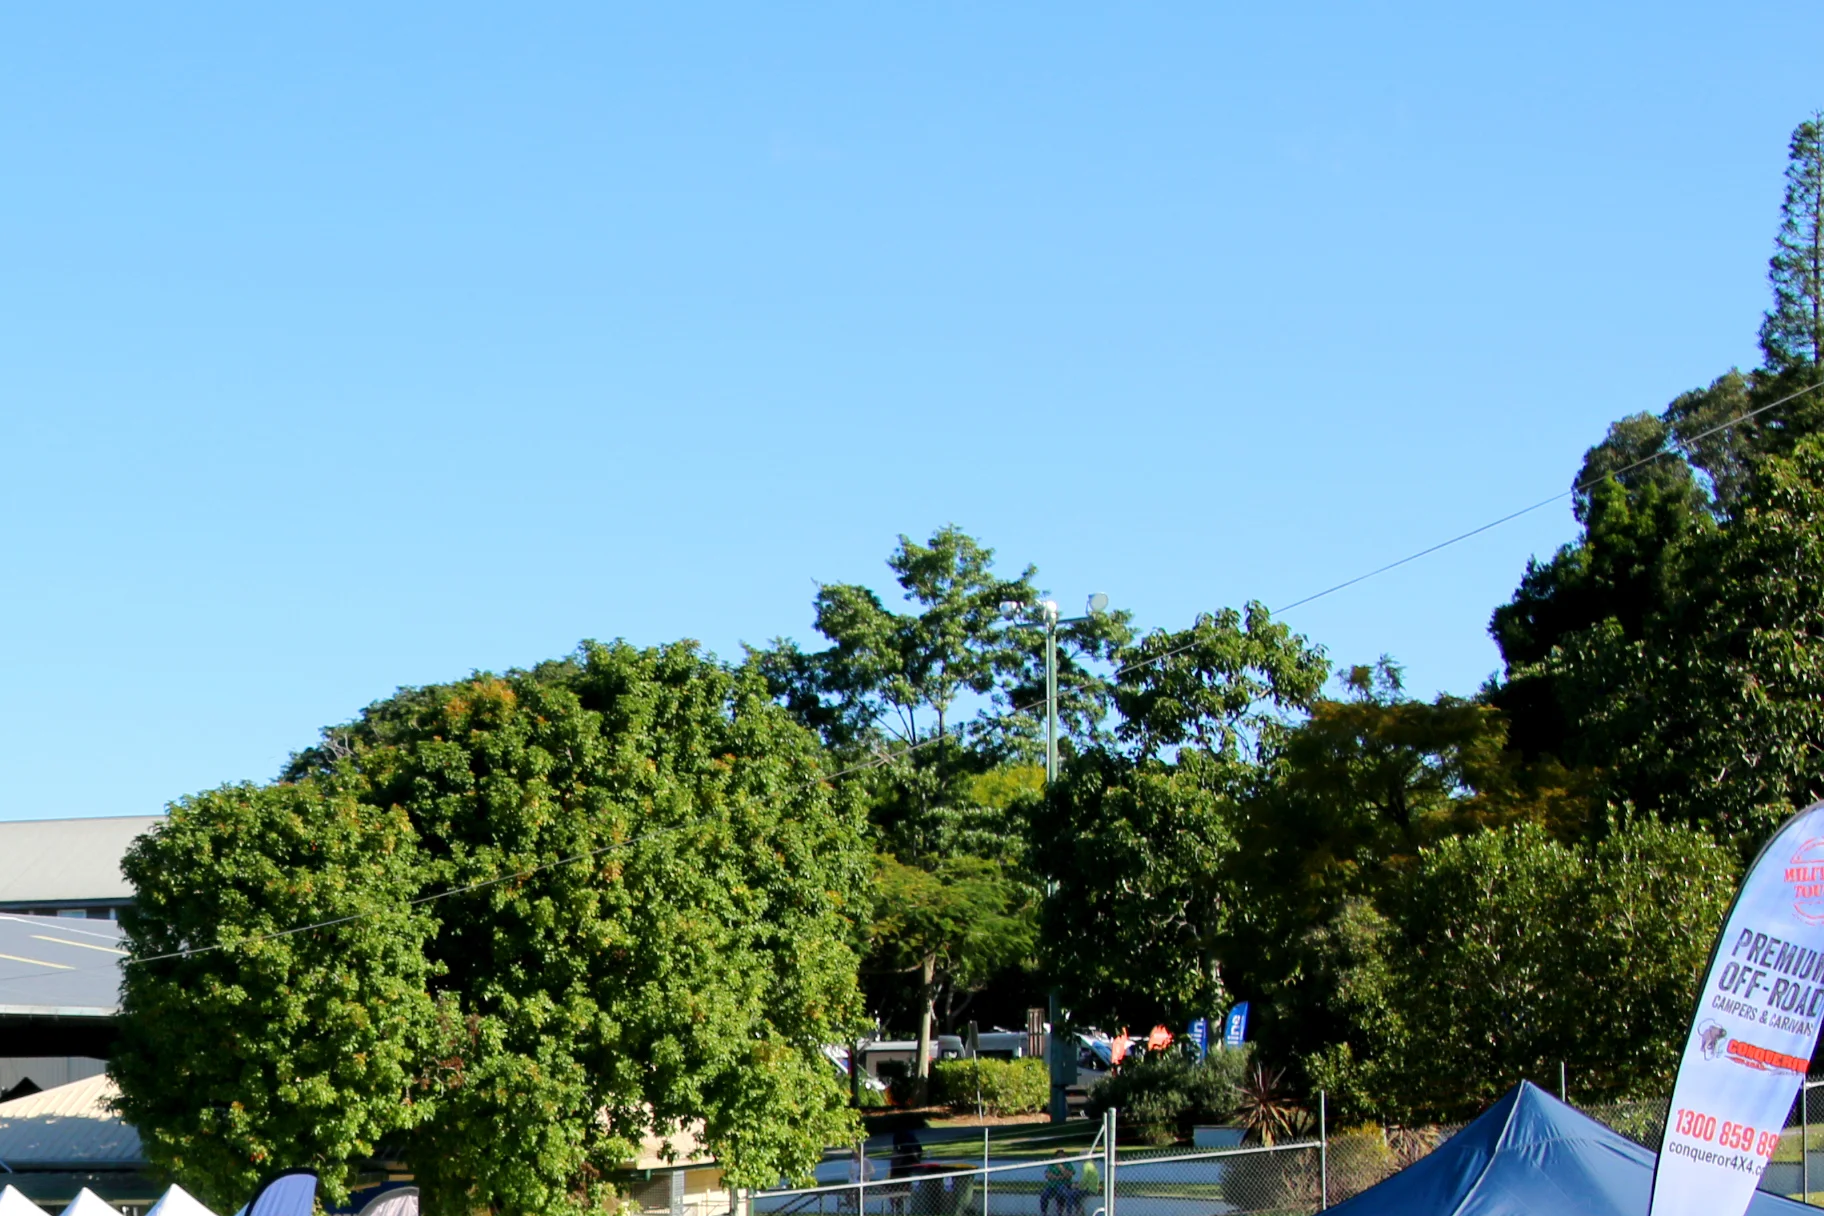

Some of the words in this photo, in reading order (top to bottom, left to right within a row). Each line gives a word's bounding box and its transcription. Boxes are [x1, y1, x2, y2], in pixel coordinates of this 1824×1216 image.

[1784, 866, 1824, 883] MILIT
[1795, 885, 1824, 898] TOU
[1719, 961, 1824, 1018] OFF-ROAD
[1712, 994, 1757, 1021] CAMPERS
[1759, 1010, 1768, 1024] &
[1676, 1109, 1716, 1141] 1300
[1719, 1121, 1755, 1151] 859
[1757, 1133, 1779, 1158] 89
